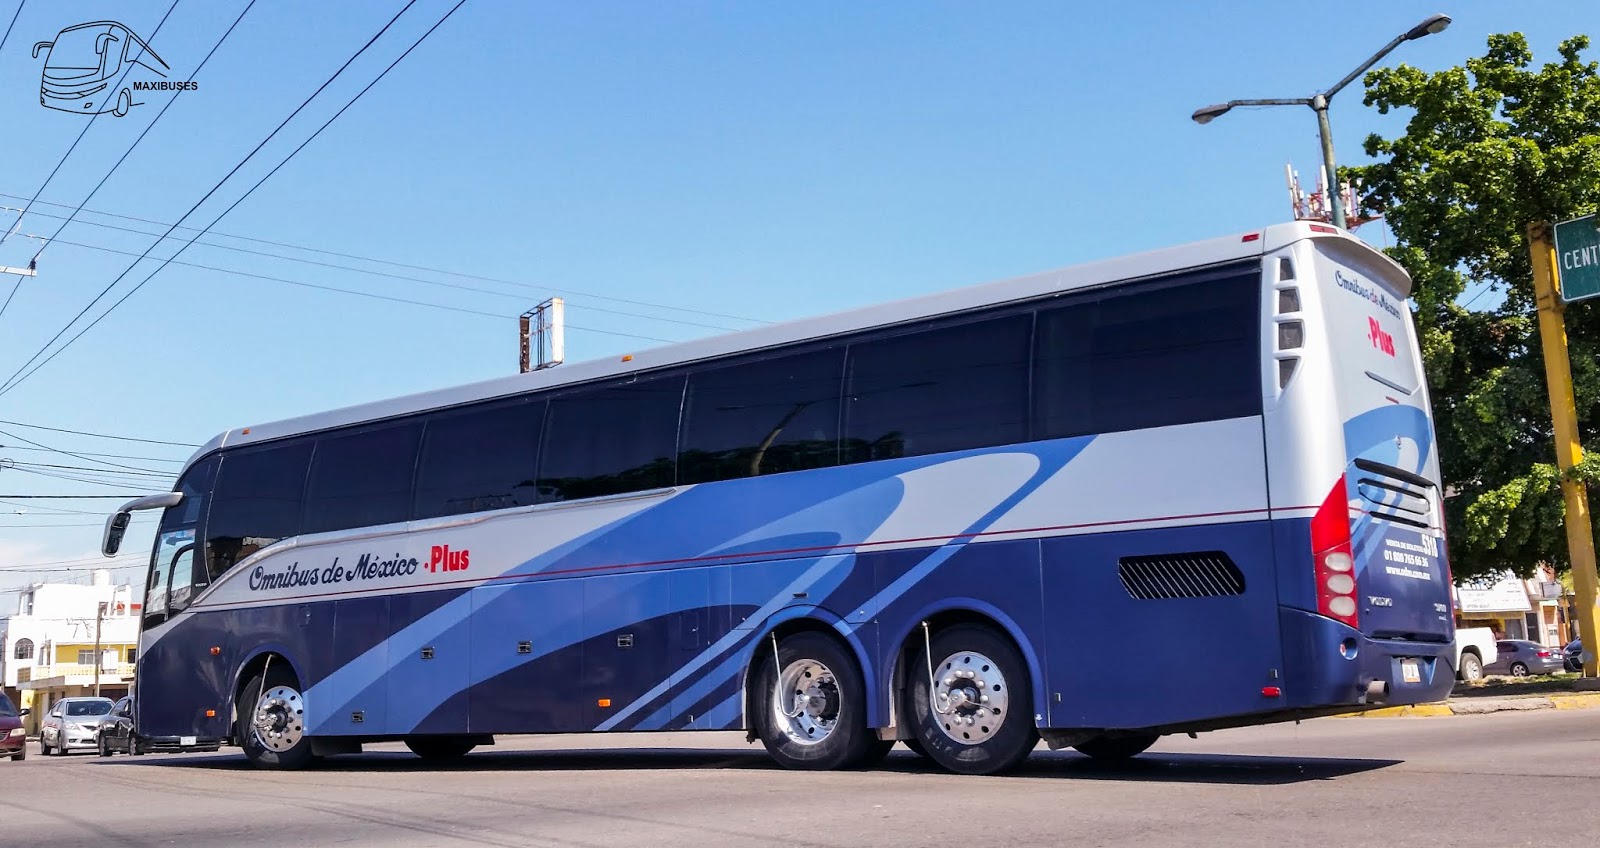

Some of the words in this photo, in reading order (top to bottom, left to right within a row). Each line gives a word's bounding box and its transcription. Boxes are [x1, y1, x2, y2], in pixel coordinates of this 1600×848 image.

[1564, 245, 1600, 270] CENT
[1384, 549, 1393, 561] 01
[249, 562, 319, 591] Omnibus
[321, 557, 342, 583] de
[346, 552, 419, 582] México
